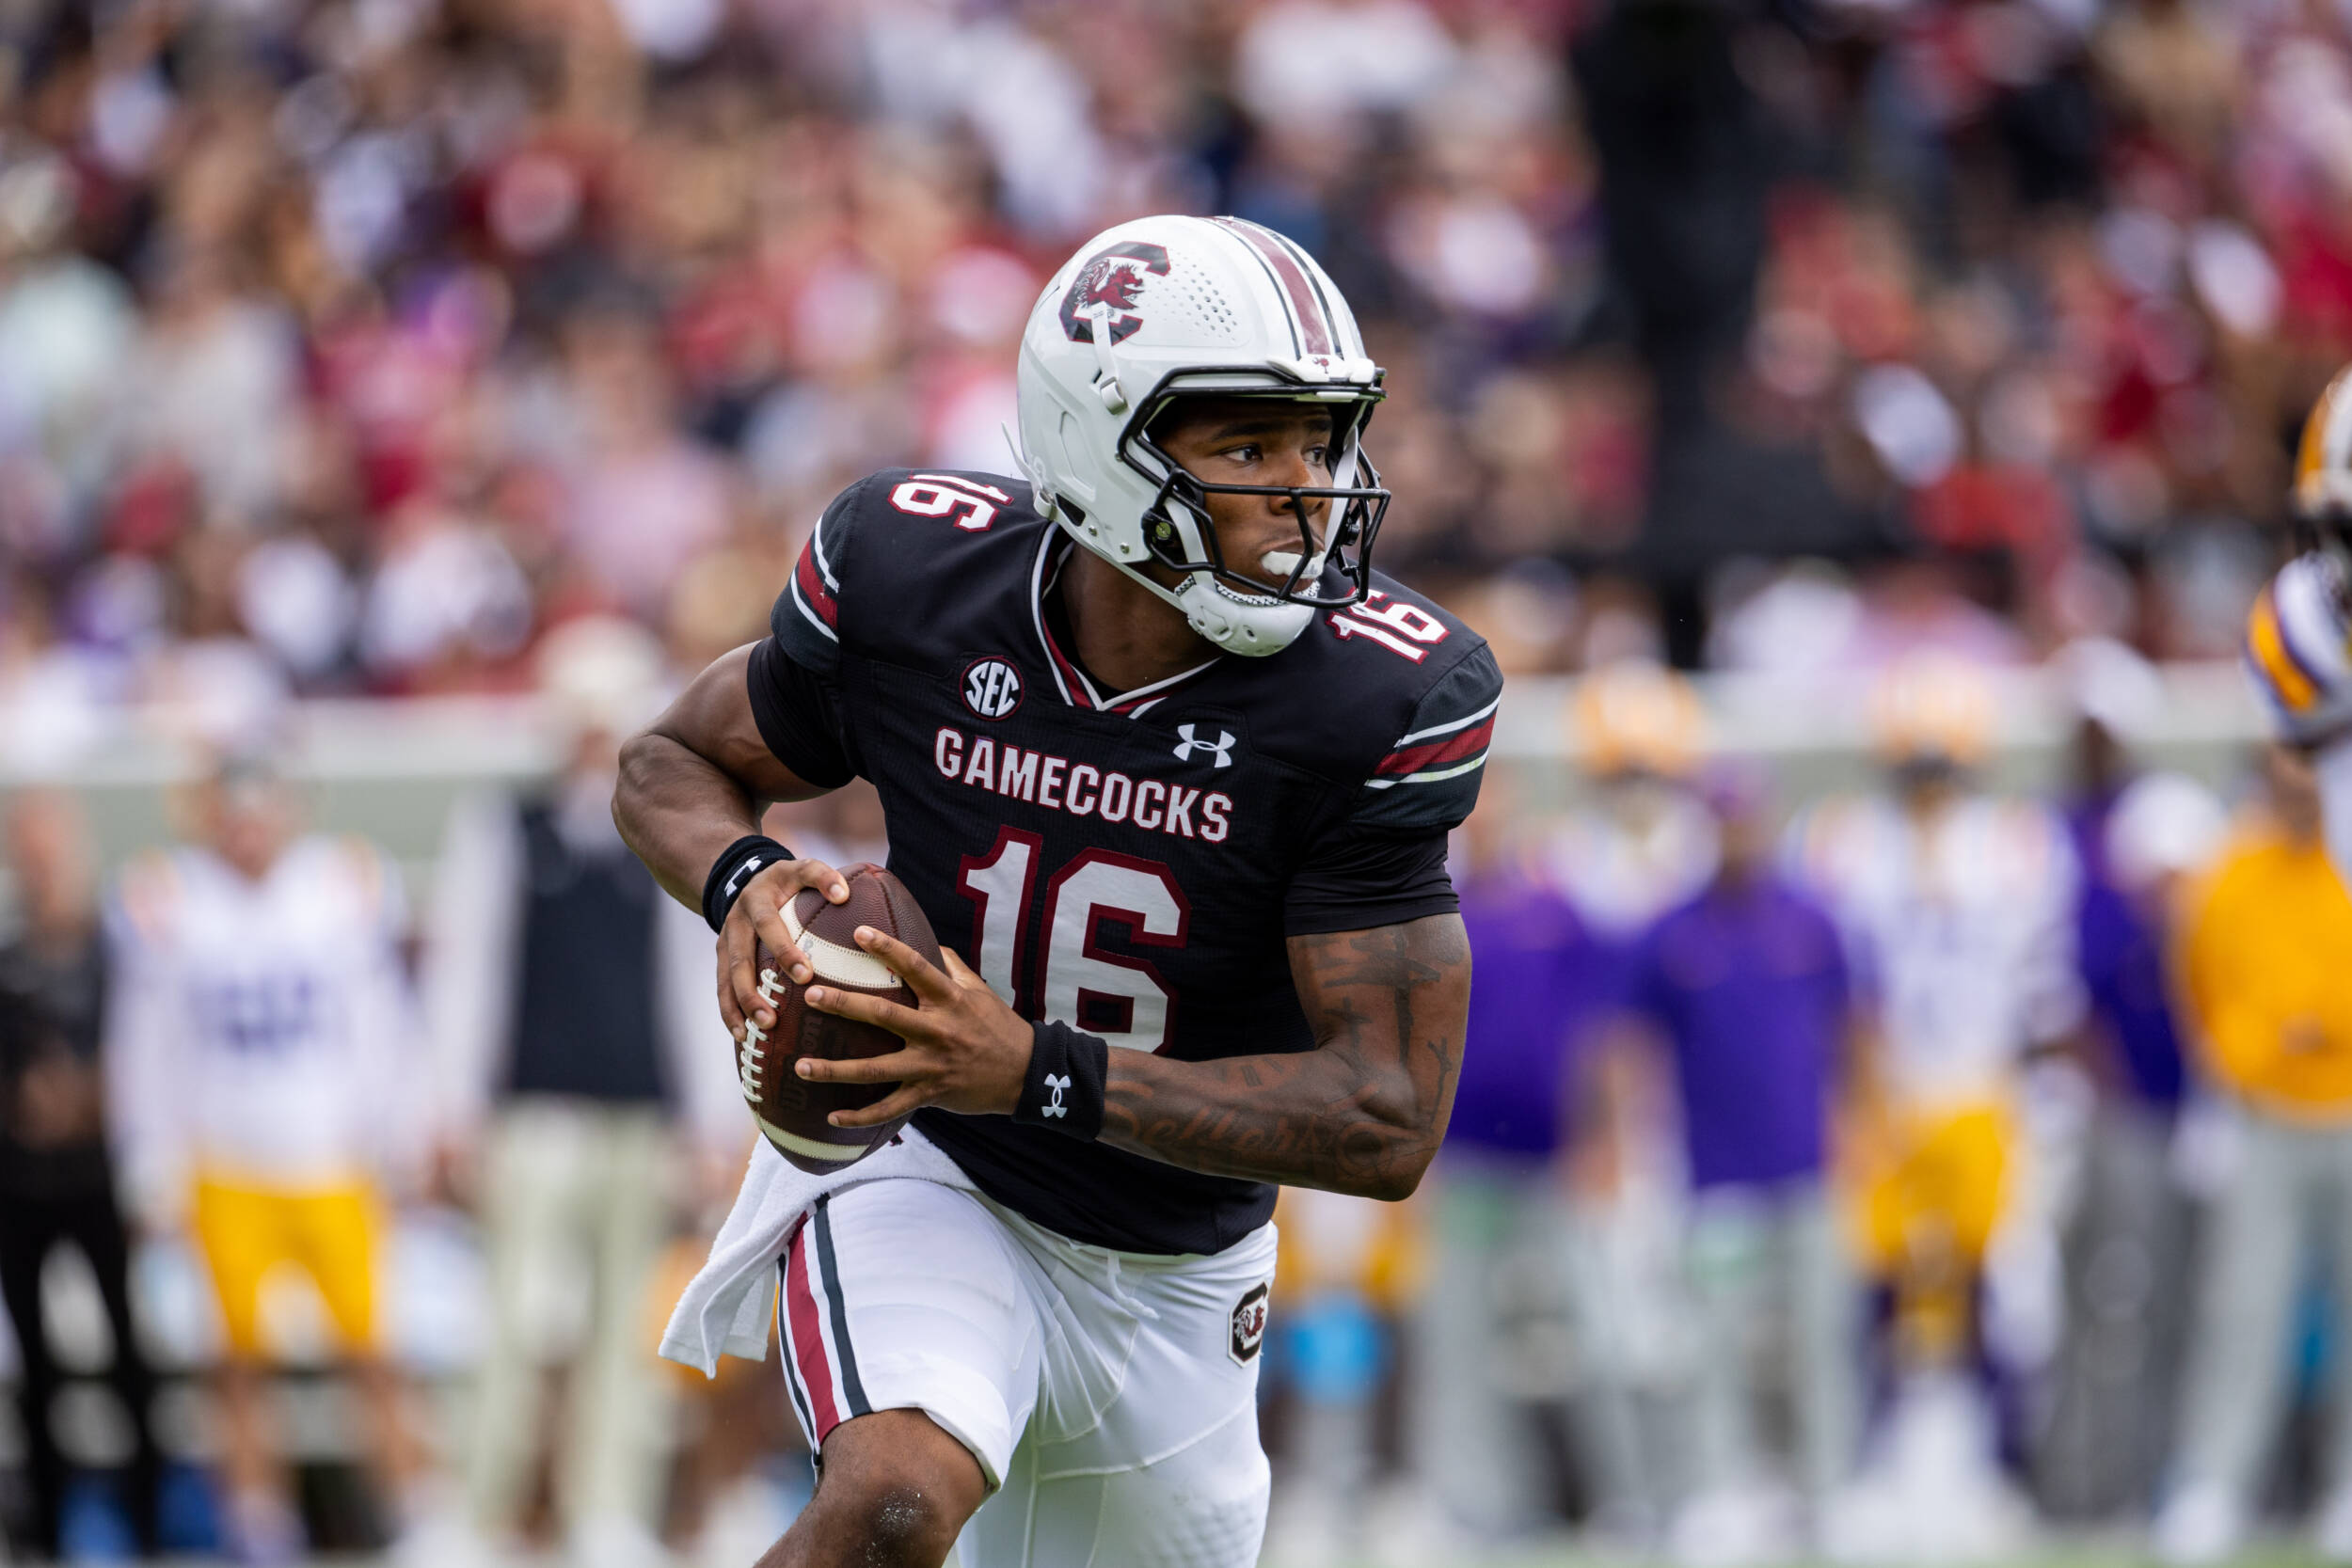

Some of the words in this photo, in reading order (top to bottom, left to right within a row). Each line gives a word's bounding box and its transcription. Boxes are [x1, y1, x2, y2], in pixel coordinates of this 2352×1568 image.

[887, 474, 1015, 533] 16
[1325, 587, 1452, 665] 16
[965, 661, 1020, 718] SEC
[935, 727, 1232, 843] GAMECOCKS
[956, 824, 1192, 1054] 16
